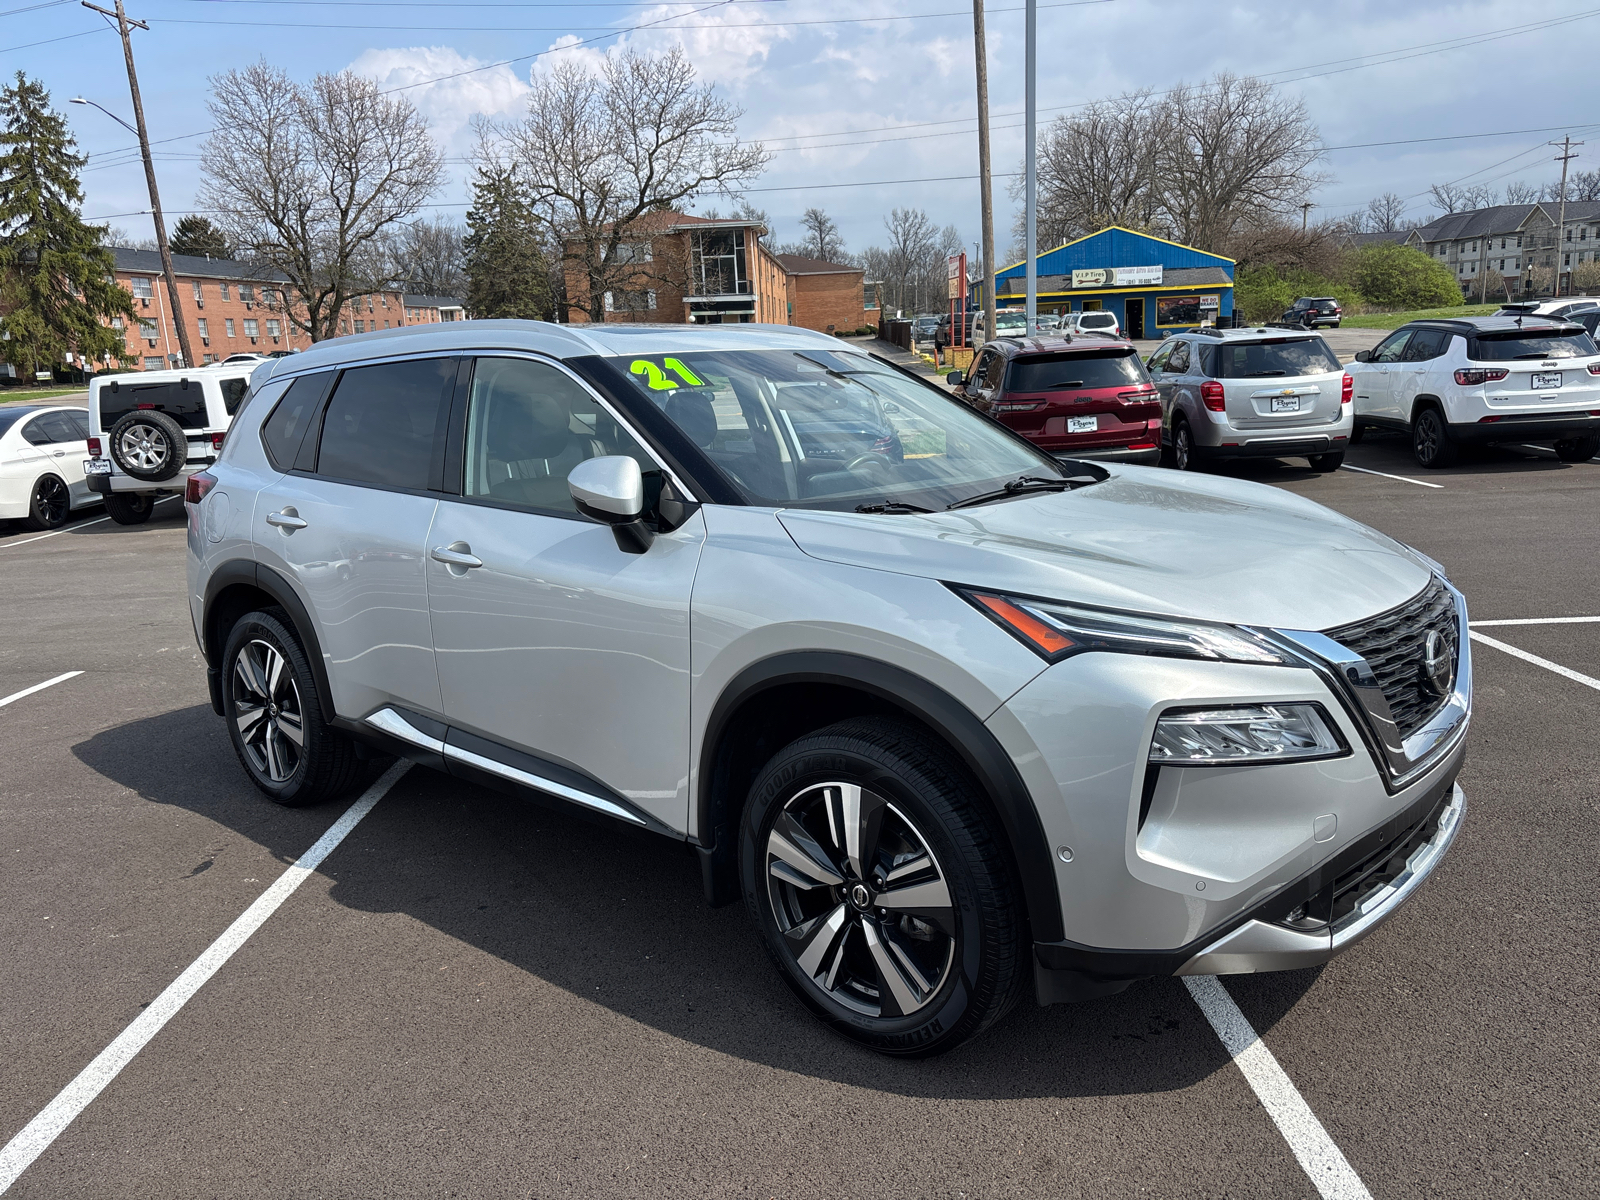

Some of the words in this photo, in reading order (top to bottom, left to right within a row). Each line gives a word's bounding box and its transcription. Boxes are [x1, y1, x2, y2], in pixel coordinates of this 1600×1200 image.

[630, 357, 705, 390] 21
[1535, 376, 1559, 384] Byers
[1274, 399, 1297, 407] Byers
[1070, 419, 1094, 428] Byers
[758, 755, 847, 808] GOODYEAR
